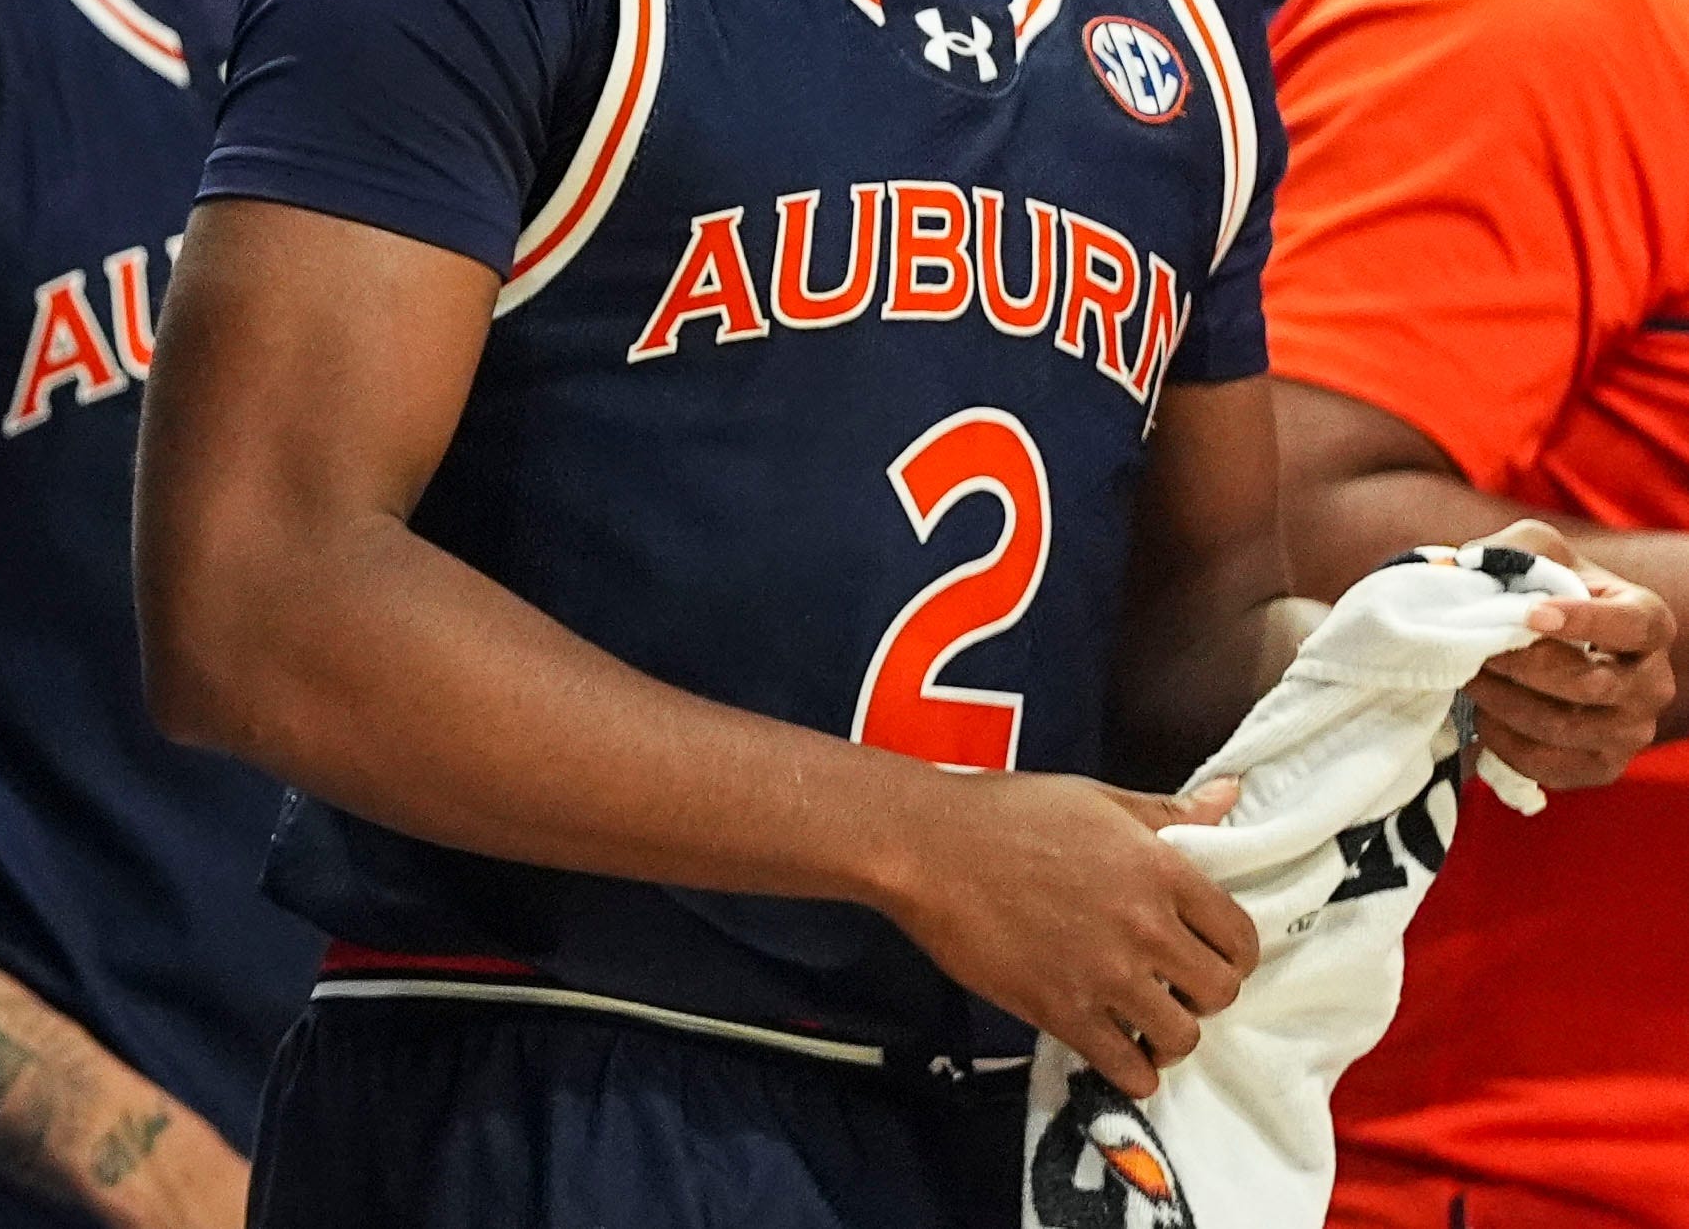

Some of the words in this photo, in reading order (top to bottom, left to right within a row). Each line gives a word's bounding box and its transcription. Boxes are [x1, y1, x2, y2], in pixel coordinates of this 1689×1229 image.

[1091, 22, 1179, 115] SEC
[626, 180, 1192, 442] AUBURN
[849, 406, 1052, 774] 2
